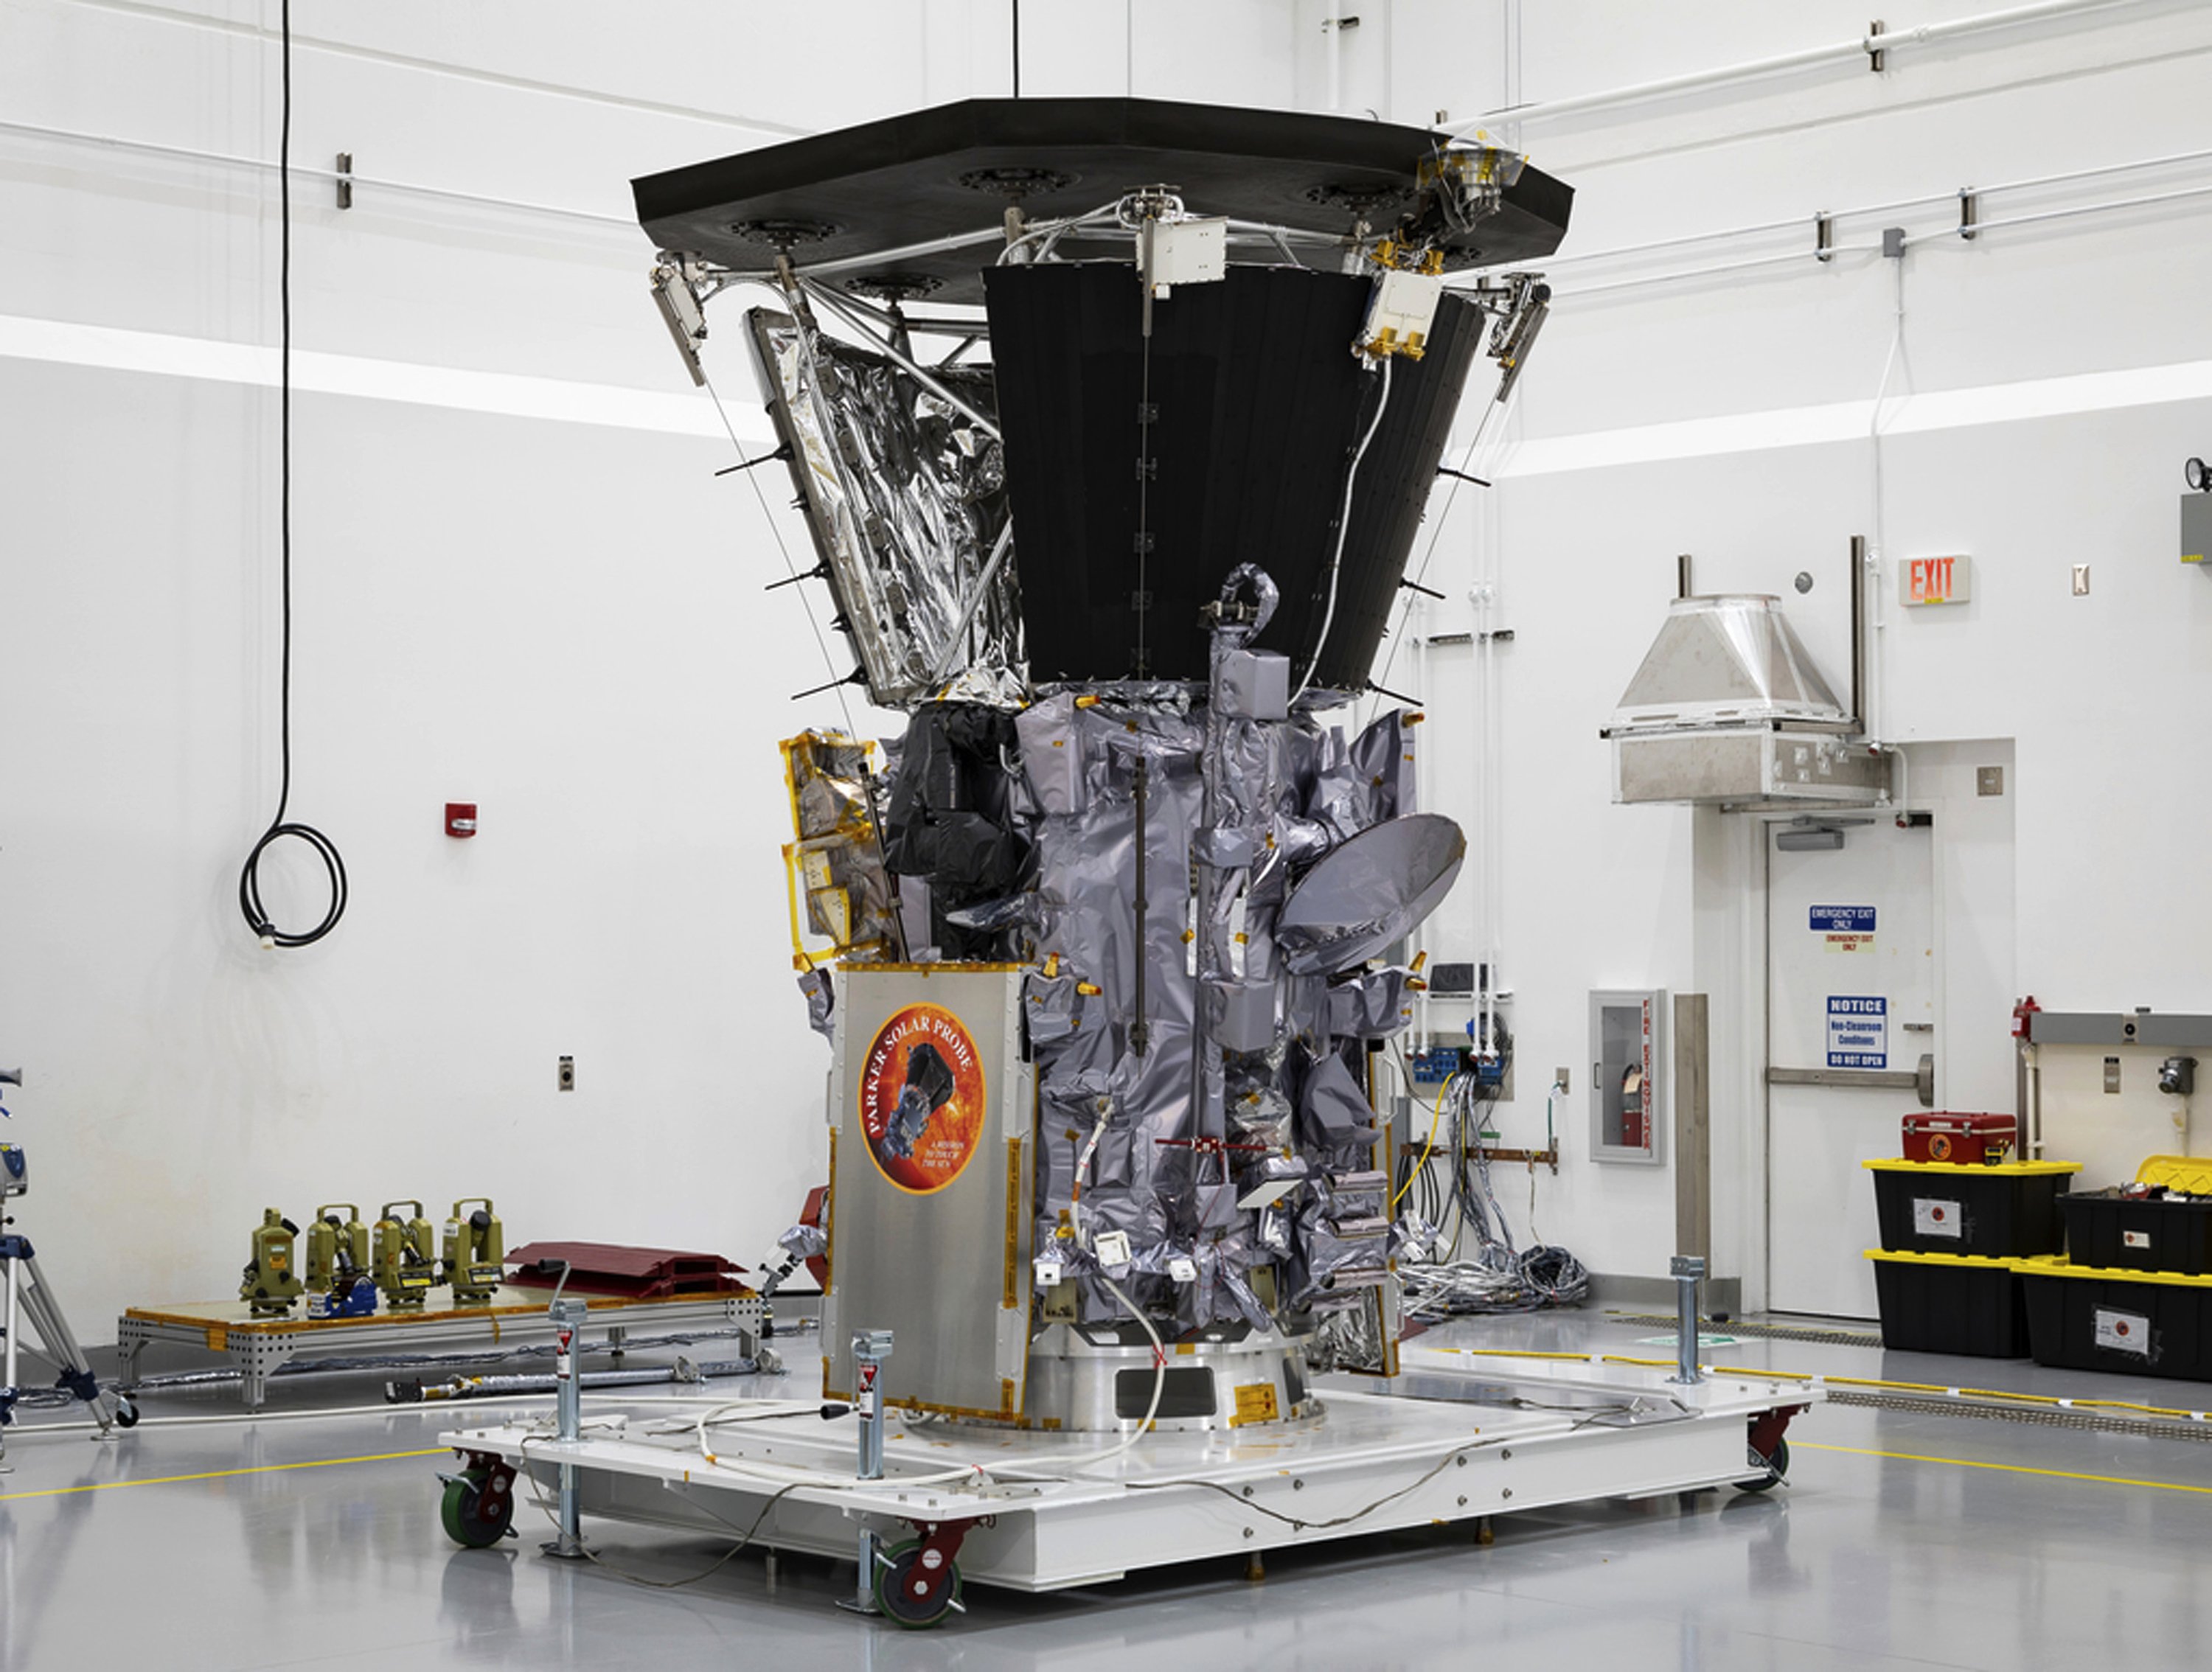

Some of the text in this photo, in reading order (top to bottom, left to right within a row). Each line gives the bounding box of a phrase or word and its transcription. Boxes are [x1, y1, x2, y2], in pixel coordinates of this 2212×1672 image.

[1910, 557, 1955, 601] EXIT
[1812, 908, 1874, 919] EMERGENCY EXIT
[1832, 919, 1852, 929] ONLY
[1843, 943, 1856, 951] ONLY
[1831, 1000, 1882, 1012] NOTICE
[1832, 1021, 1882, 1032] Non-Cleanroom
[1838, 1034, 1875, 1045] Conditions
[1831, 1054, 1882, 1066] DO NOT OPEN
[866, 1016, 972, 1133] PARKER SOLAR PROBE
